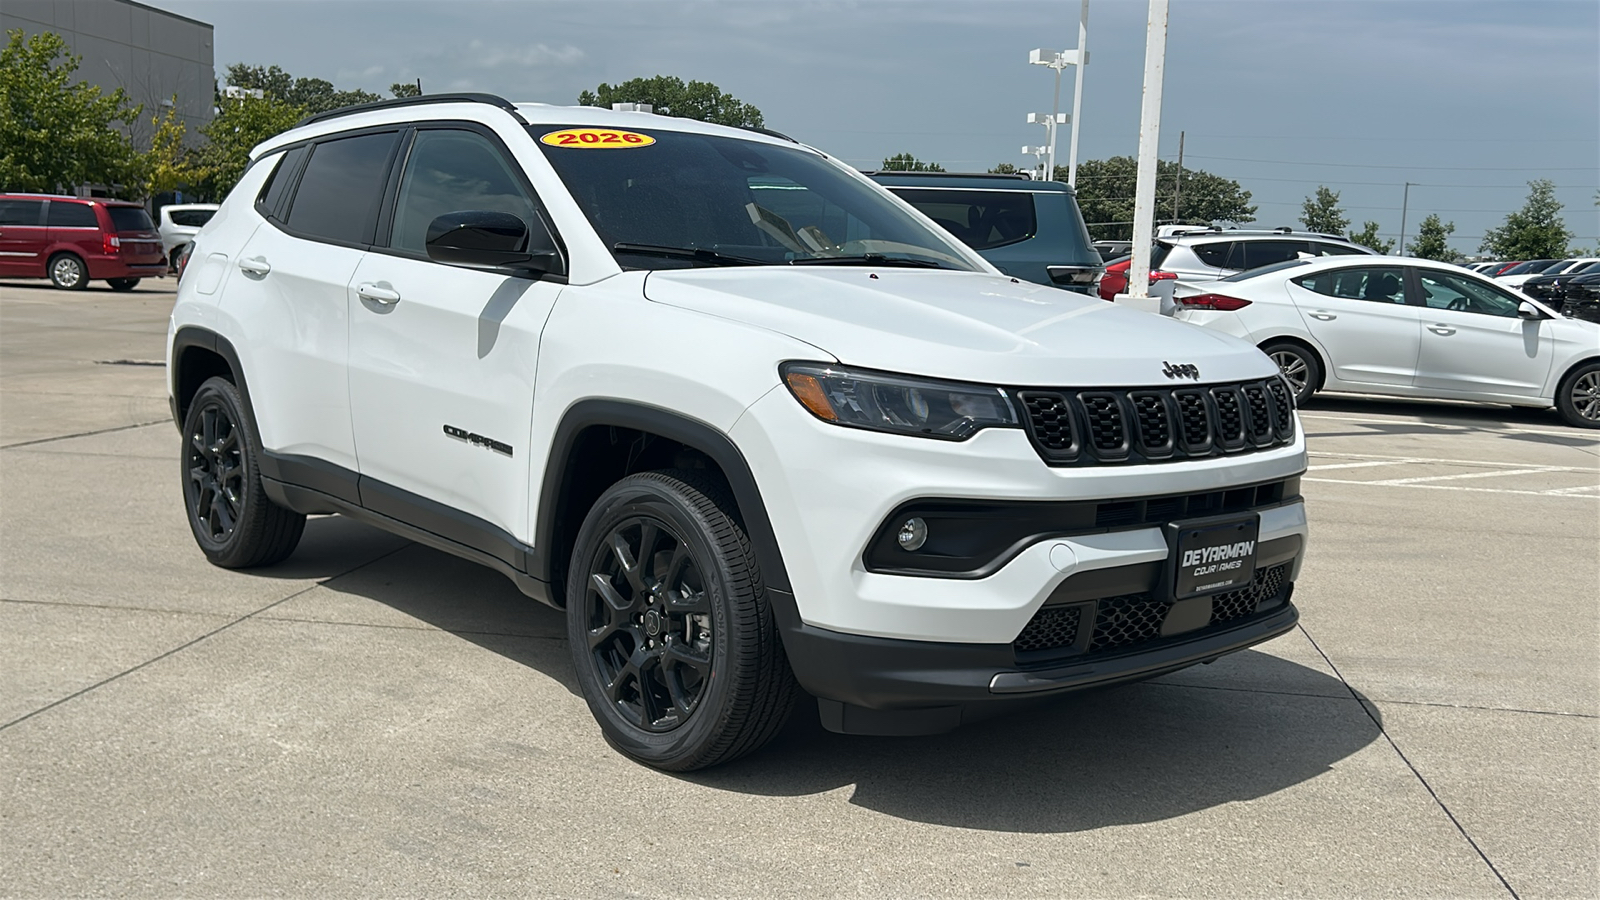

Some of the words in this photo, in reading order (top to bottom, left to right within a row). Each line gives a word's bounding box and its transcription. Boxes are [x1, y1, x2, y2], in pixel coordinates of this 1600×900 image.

[557, 133, 643, 145] 2026
[1162, 361, 1200, 381] Jeep
[1182, 541, 1254, 567] DEYARMAN
[1219, 560, 1242, 571] AMES
[713, 588, 725, 657] YOKOHAMA
